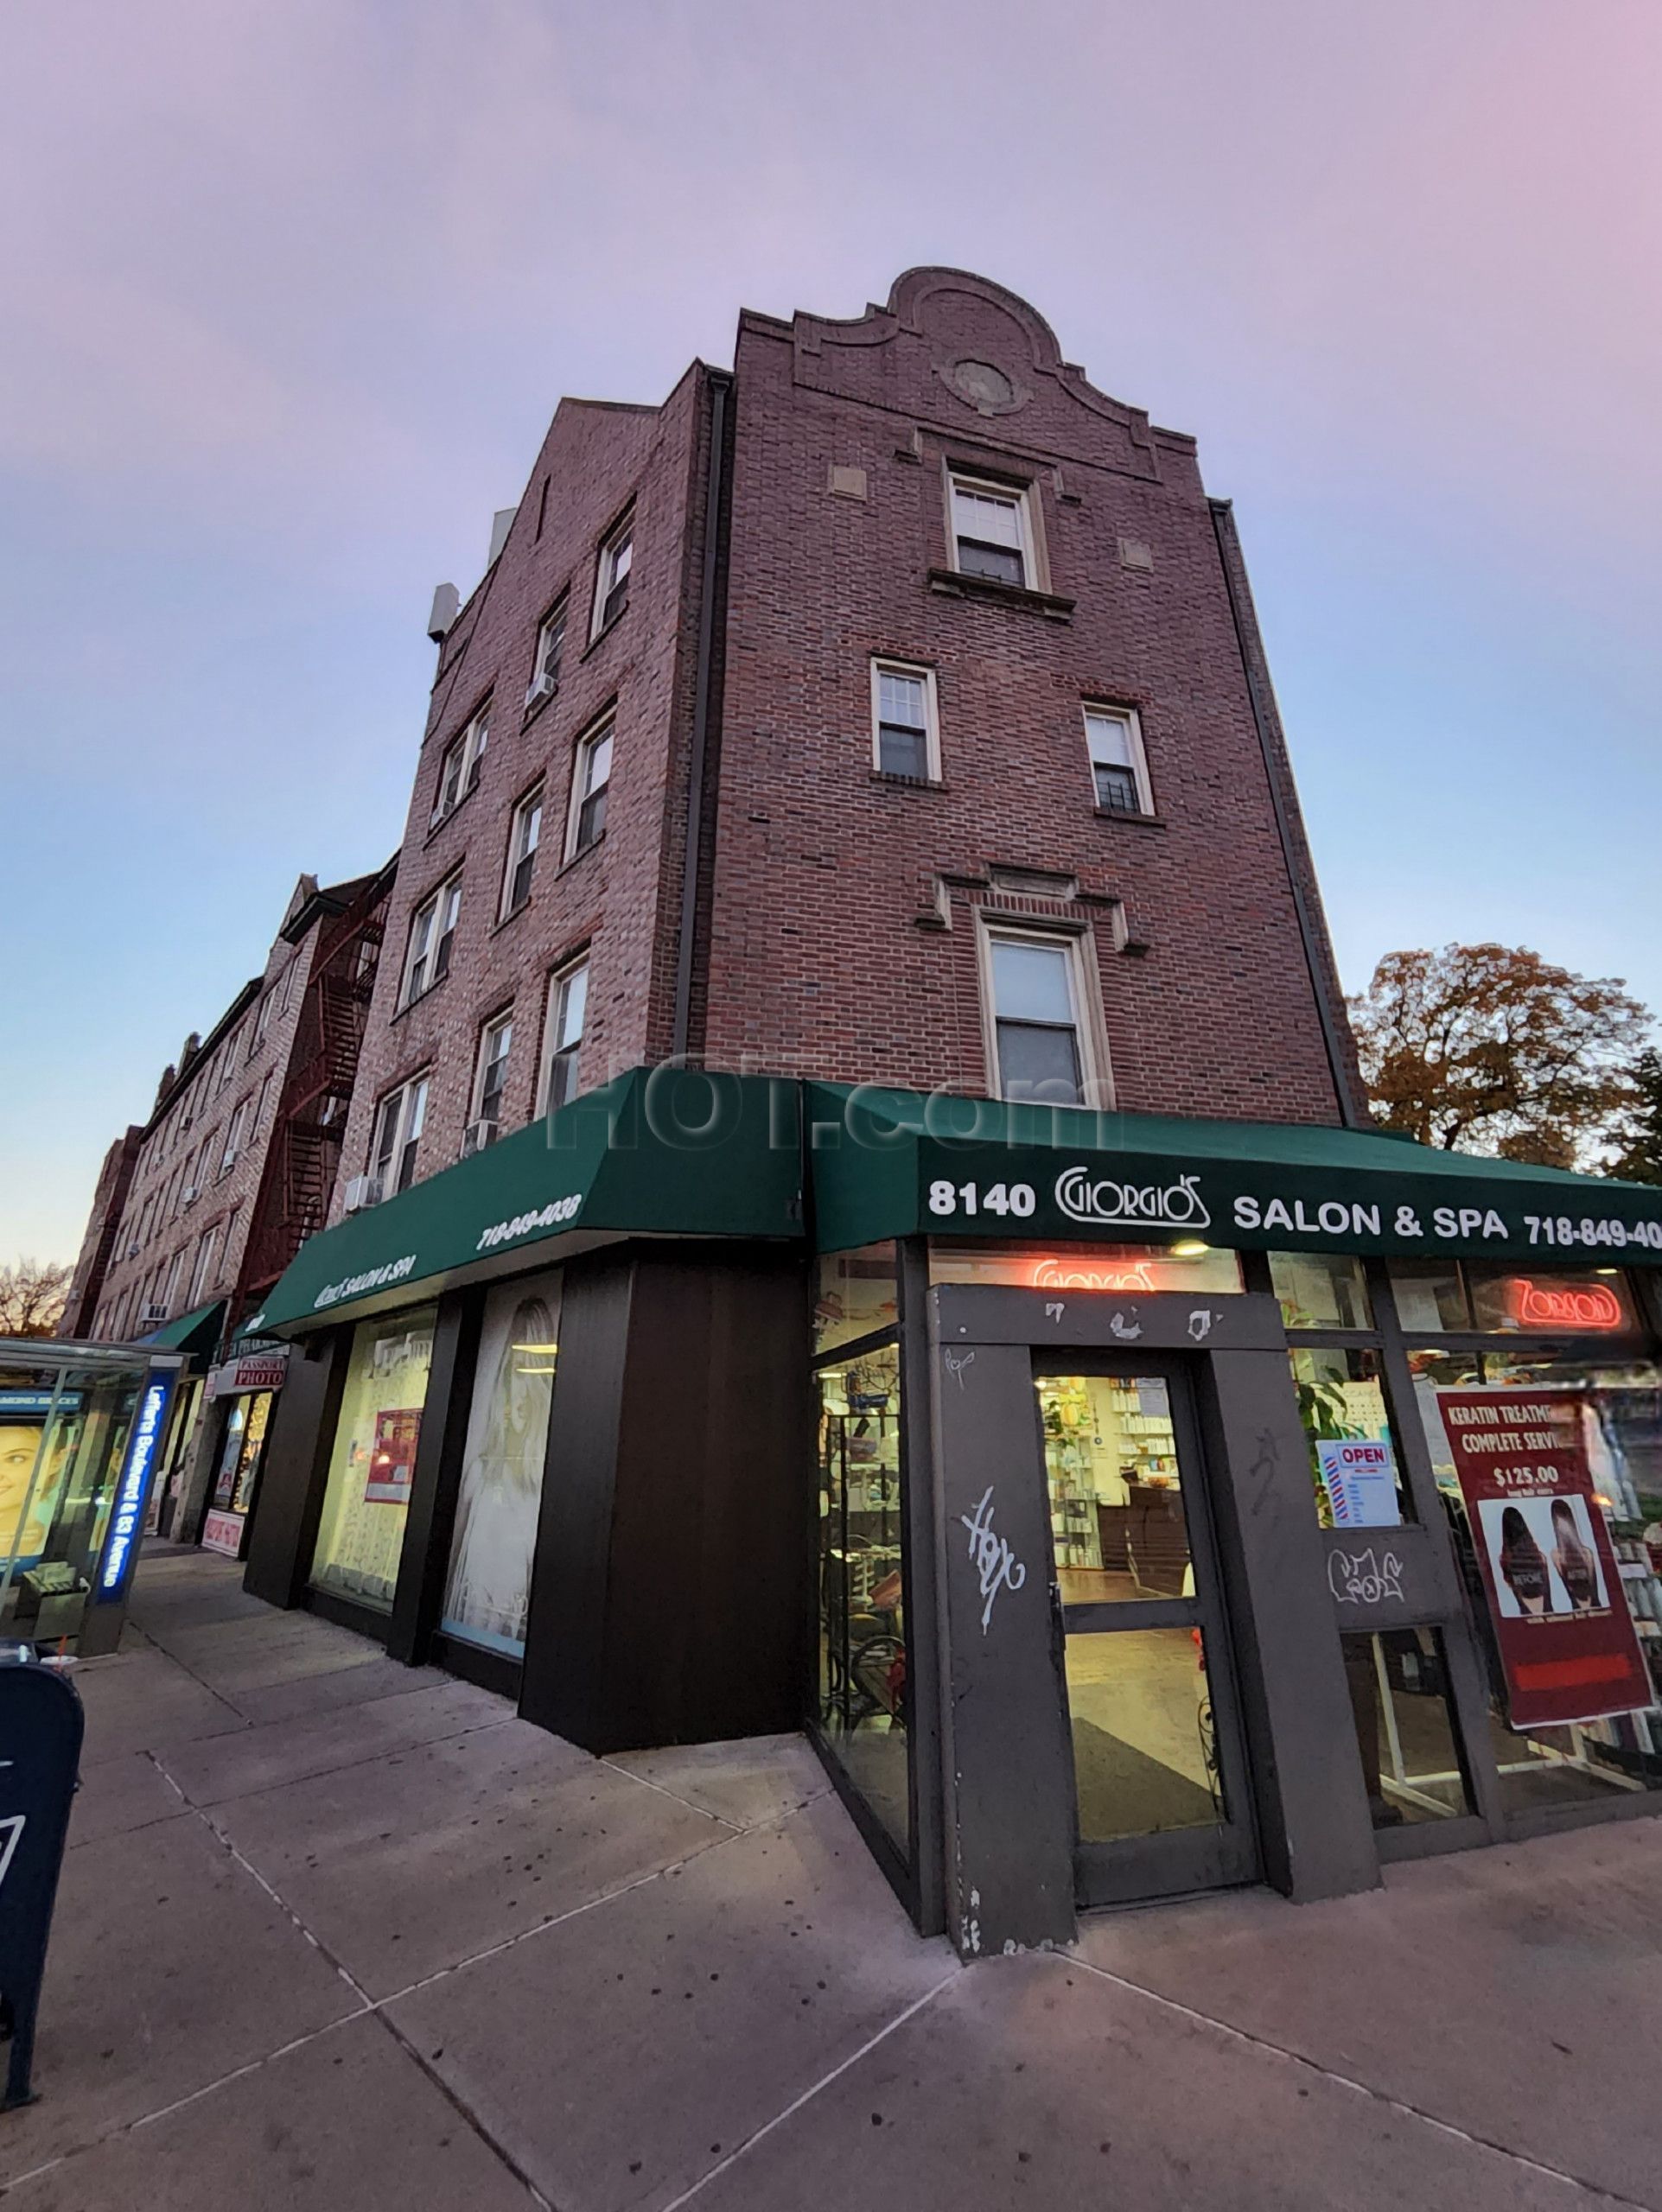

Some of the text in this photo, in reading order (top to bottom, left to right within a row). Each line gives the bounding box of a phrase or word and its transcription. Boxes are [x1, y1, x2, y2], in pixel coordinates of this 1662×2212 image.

[929, 1180, 1036, 1217] 8140
[1233, 1196, 1380, 1236] SALON
[1394, 1206, 1423, 1237] &
[1434, 1208, 1508, 1239] SPA
[1524, 1216, 1662, 1249] 718-849-40
[388, 1255, 417, 1281] SPA
[238, 1372, 283, 1383] PHOTO
[139, 1386, 164, 1434] Lefferts
[1448, 1407, 1500, 1425] KERATIN
[1462, 1432, 1524, 1453] COMPLETE
[1342, 1448, 1385, 1463] OPEN
[123, 1435, 153, 1502] Boulevard
[1493, 1466, 1559, 1487] $125.00
[104, 1535, 129, 1587] Avenue
